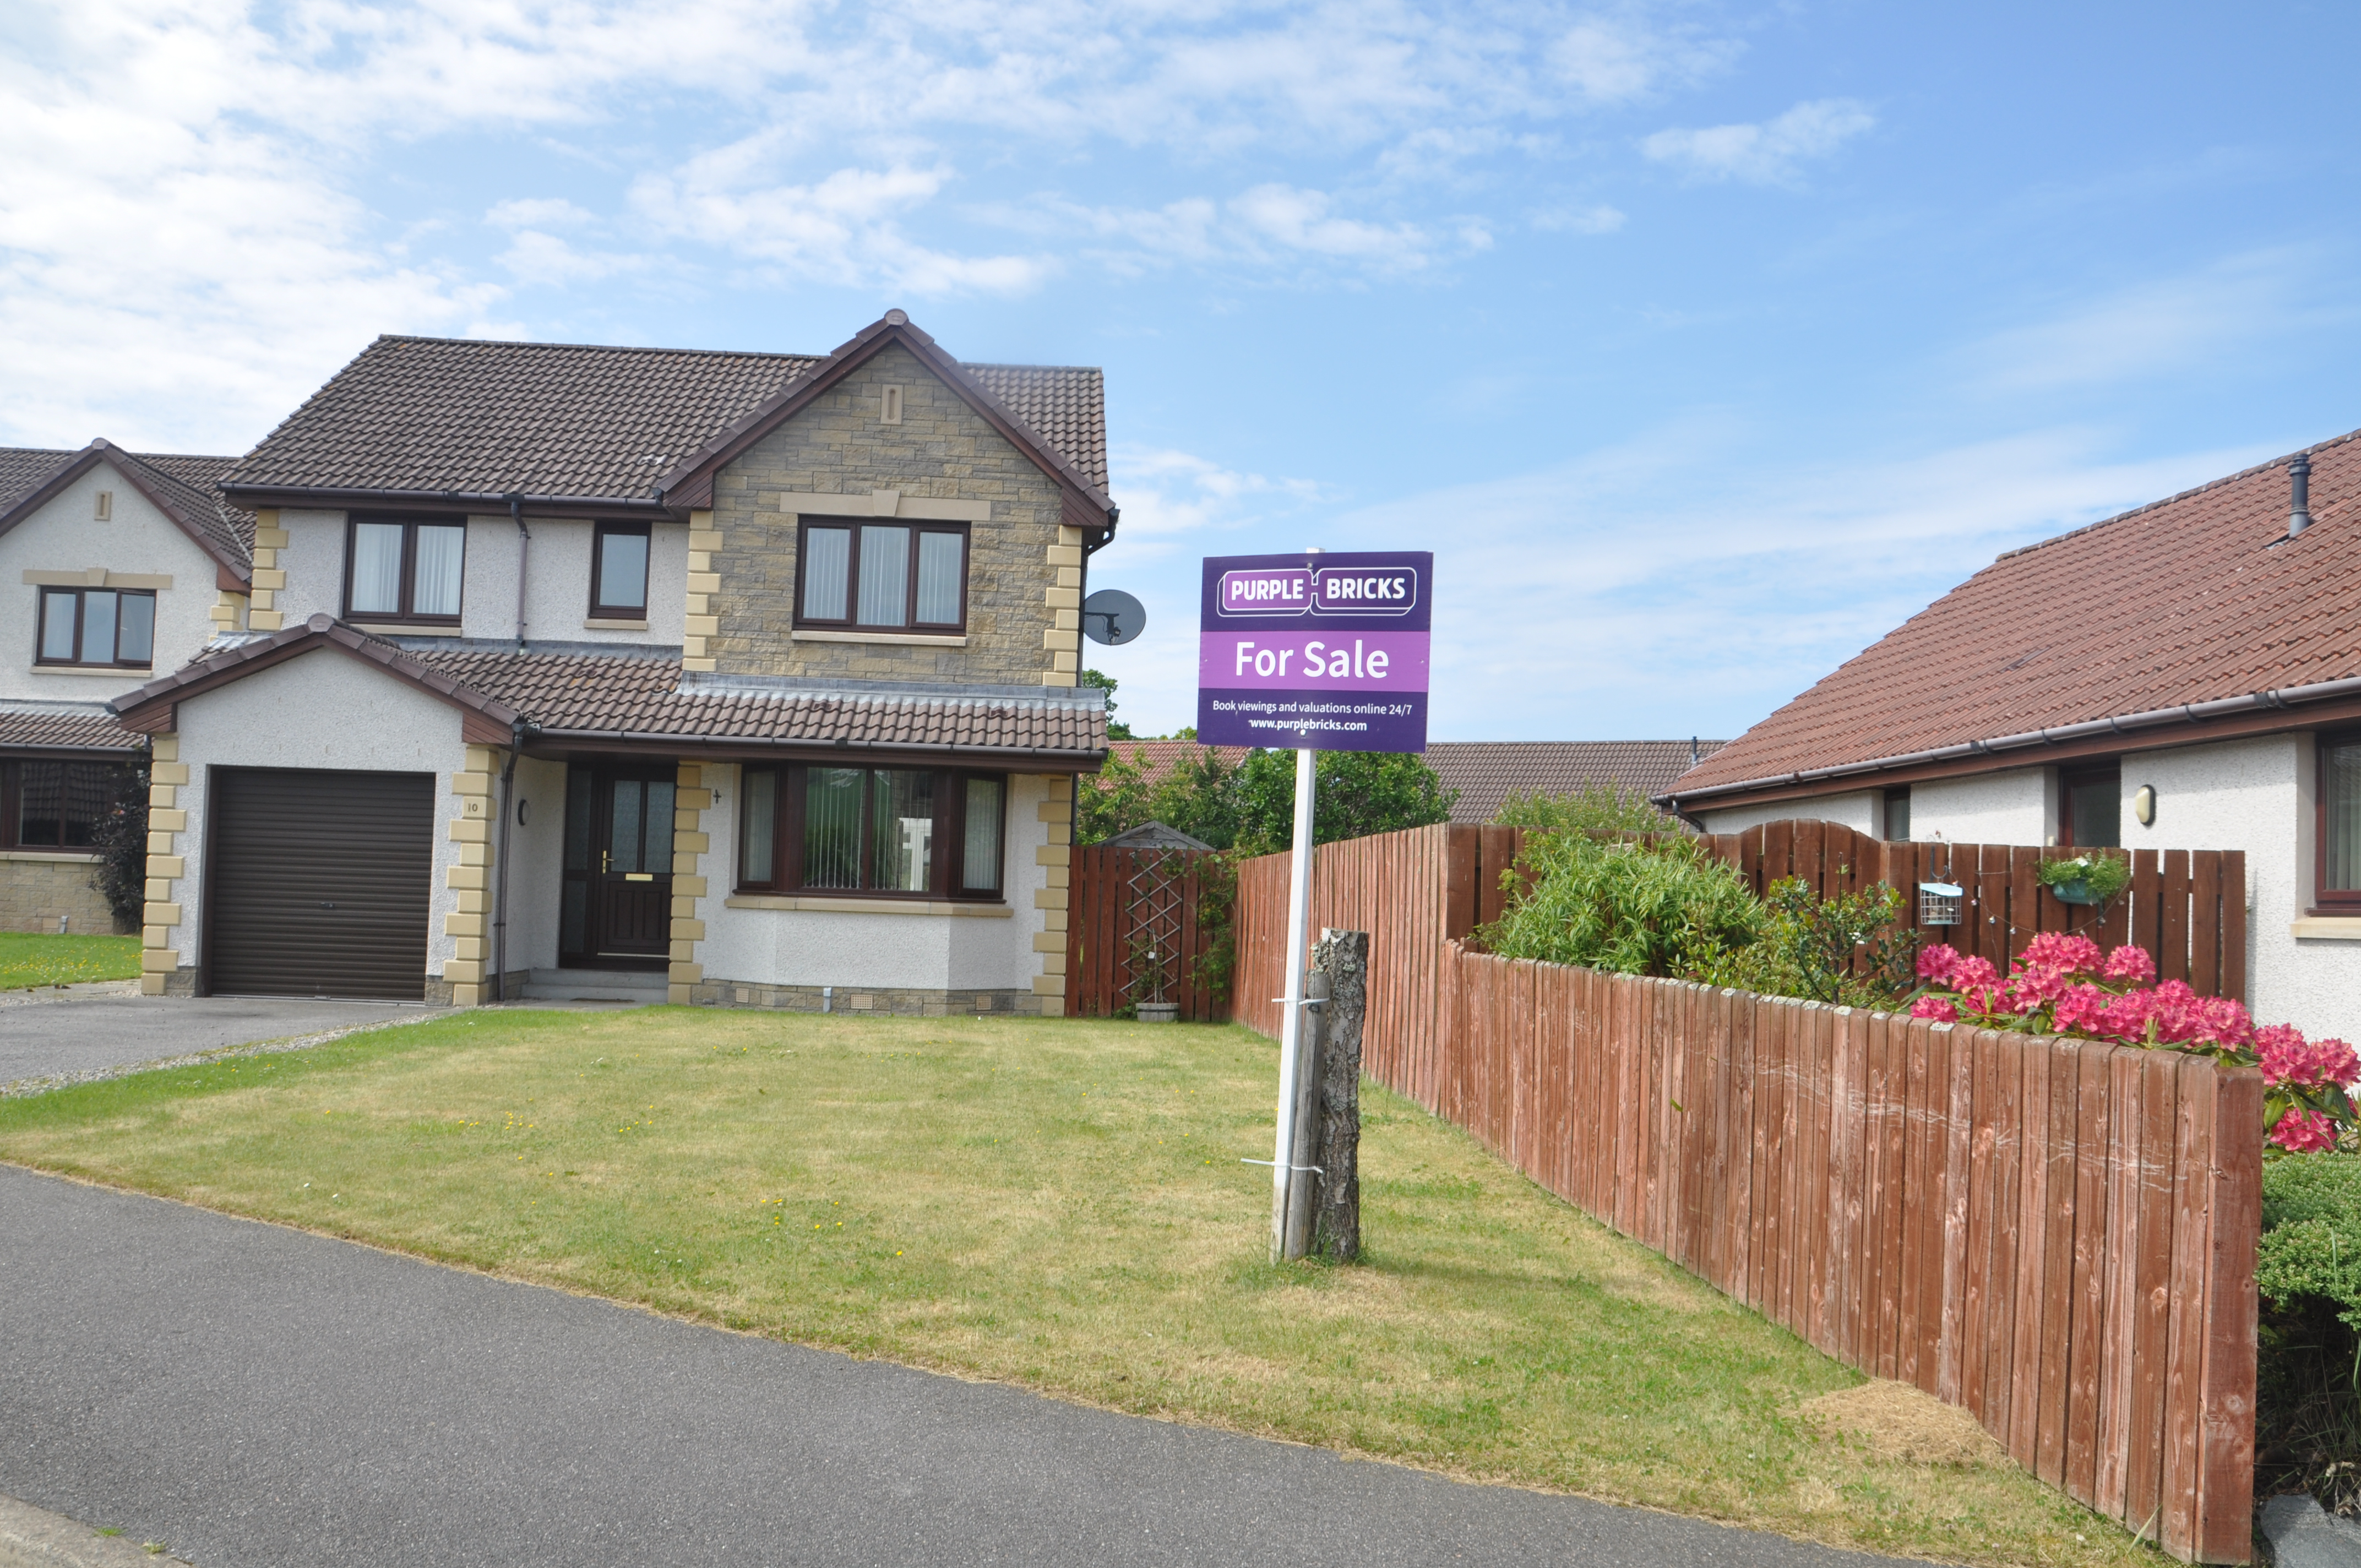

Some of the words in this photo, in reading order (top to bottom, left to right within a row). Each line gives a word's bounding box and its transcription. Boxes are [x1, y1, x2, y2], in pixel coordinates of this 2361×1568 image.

[1231, 579, 1304, 601] PURPLE
[1326, 578, 1405, 599] BRICKS
[1236, 641, 1294, 677] For
[1303, 639, 1389, 678] Sale
[1213, 700, 1236, 711] Book
[1238, 701, 1277, 714] viewings
[1279, 701, 1297, 712] and
[1298, 701, 1352, 713] valuations
[1353, 703, 1387, 715] online
[1389, 704, 1412, 717] 24/7
[1250, 717, 1367, 731] www.purplebricks.com
[467, 803, 478, 812] 10
